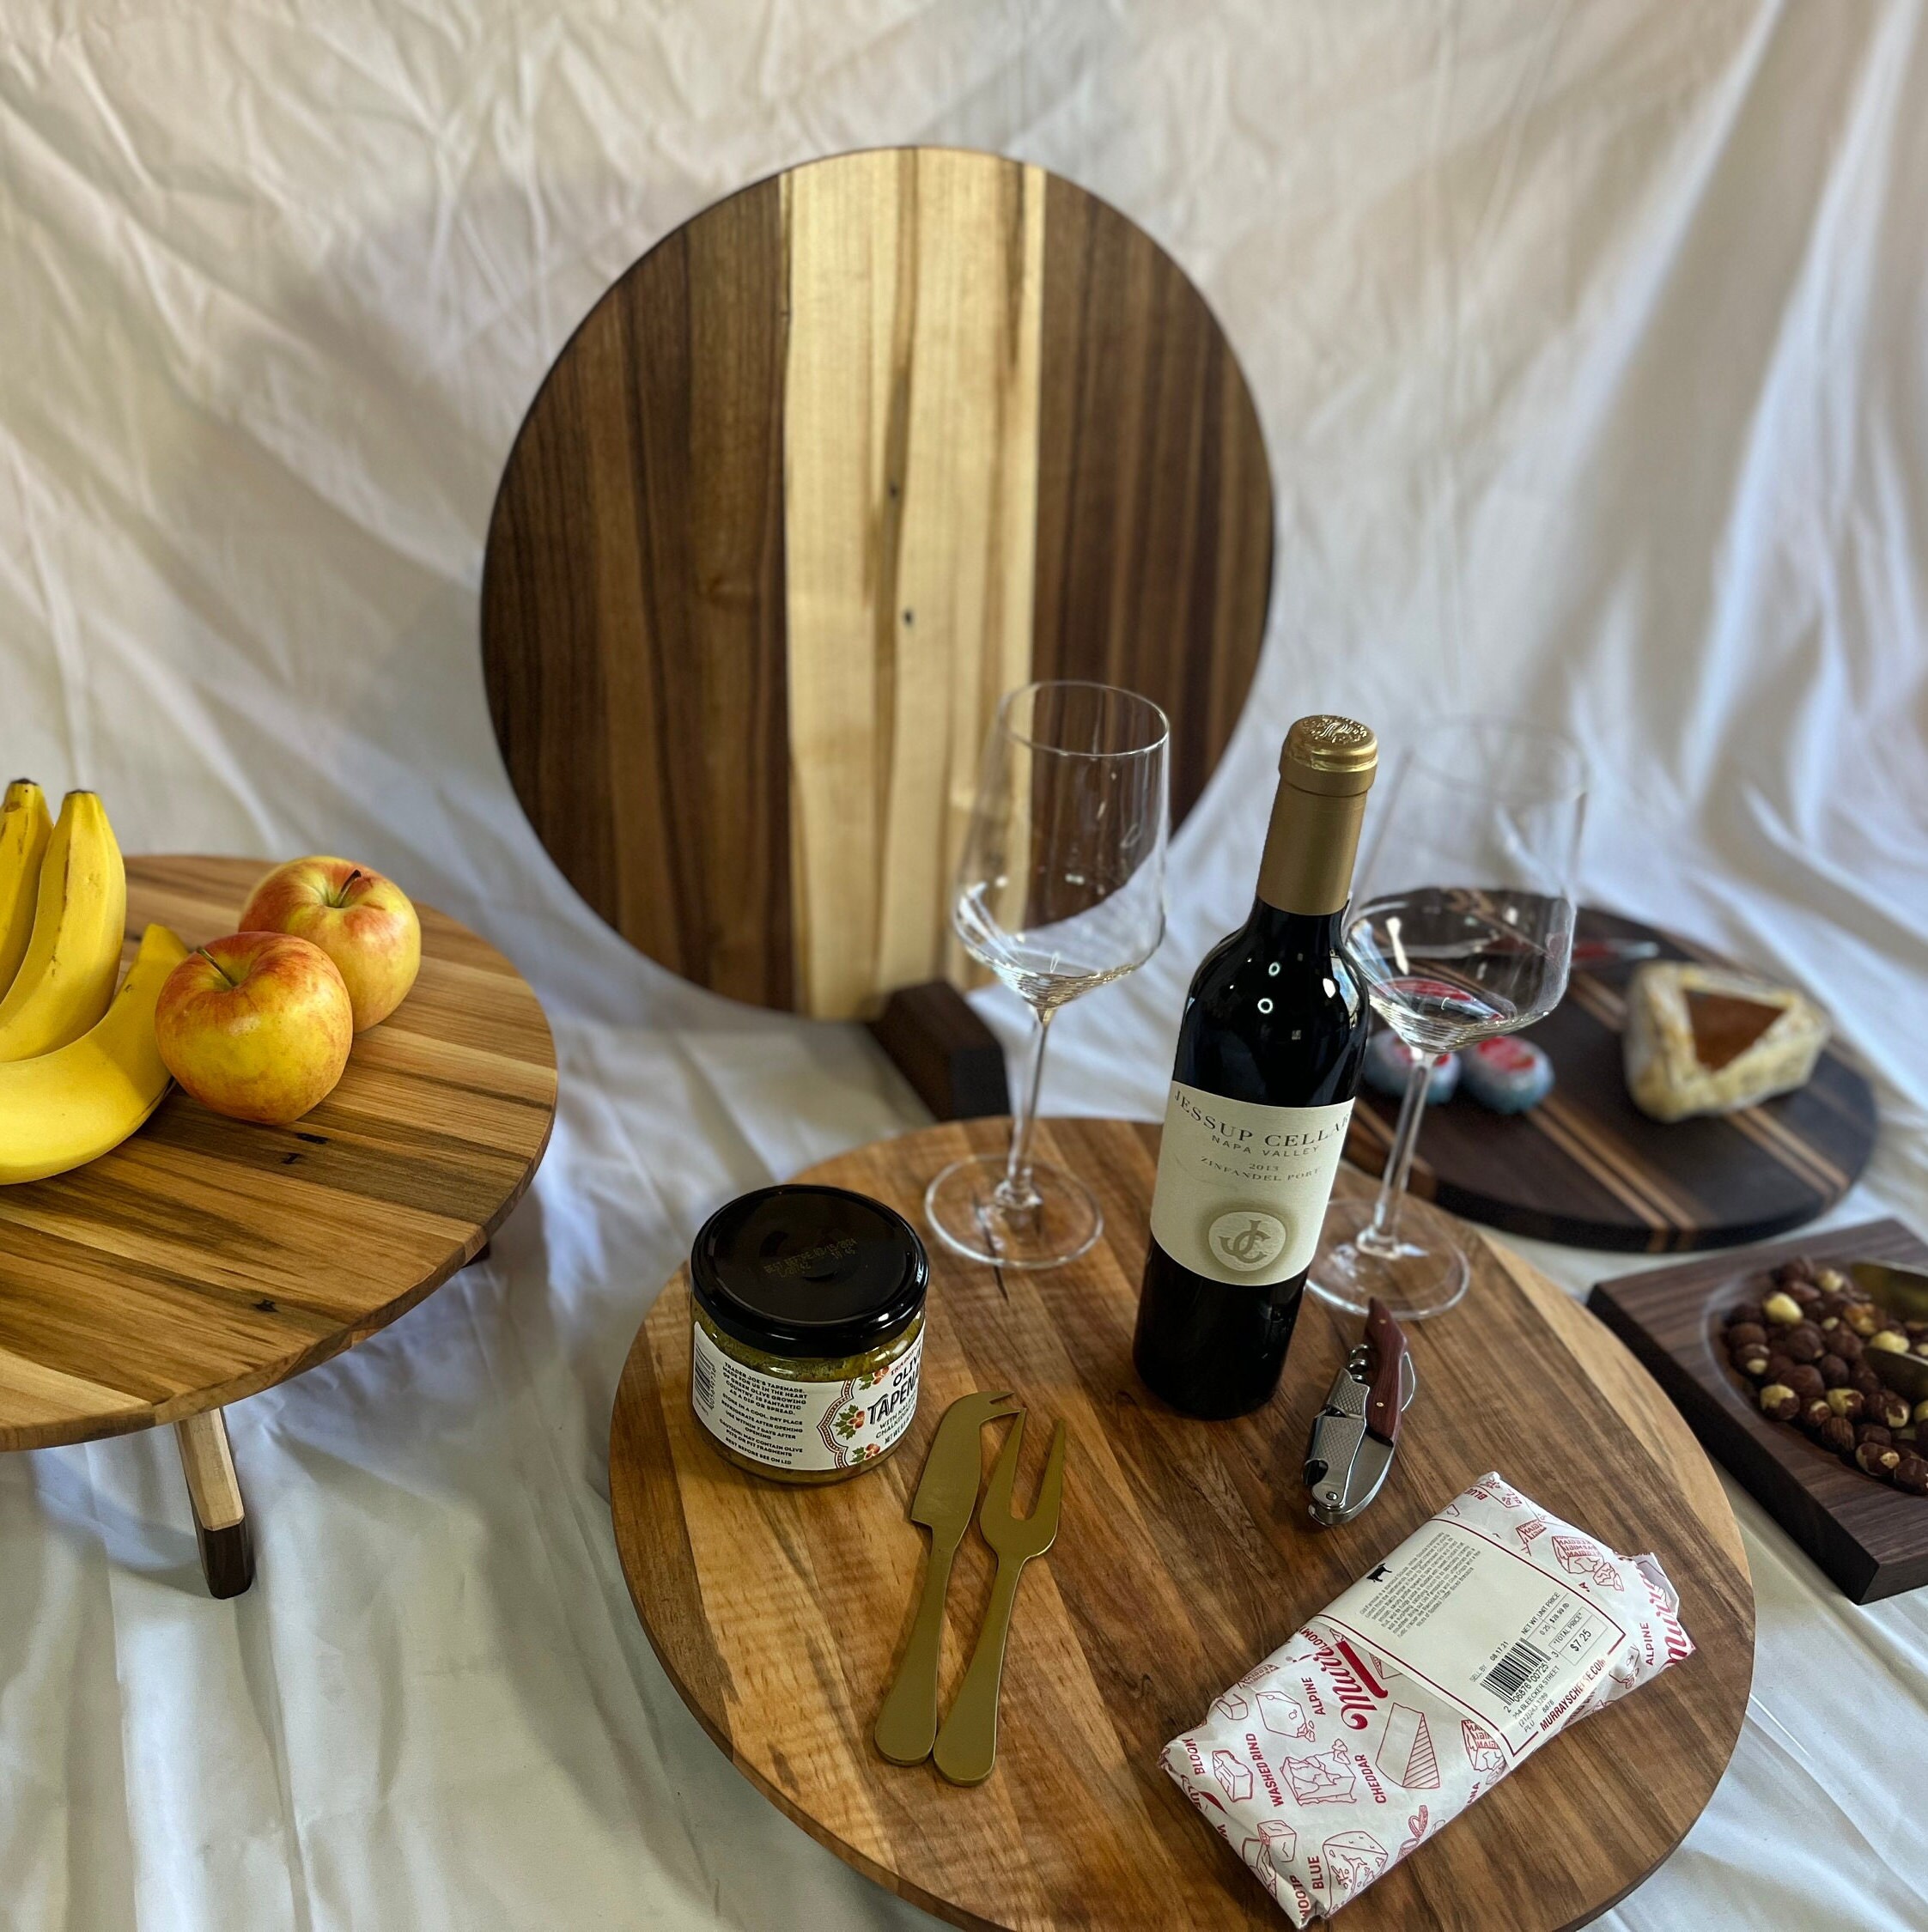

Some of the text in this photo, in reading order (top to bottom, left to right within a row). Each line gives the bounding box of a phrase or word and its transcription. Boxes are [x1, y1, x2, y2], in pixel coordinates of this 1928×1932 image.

[1174, 1091, 1254, 1142] JESSUP
[1212, 1134, 1319, 1157] NAPA VALLEY
[1201, 1156, 1323, 1182] ZINFANDEL PORT
[723, 1366, 738, 1379] MADE
[725, 1362, 747, 1378] TRADER
[748, 1376, 766, 1386] JOE'S
[731, 1377, 750, 1390] GREEN
[751, 1388, 769, 1399] OLIVE
[771, 1395, 806, 1405] GROWING
[764, 1400, 801, 1410] FANTASTIC
[735, 1417, 756, 1429] WITHIN
[745, 1427, 771, 1439] OPENING
[756, 1419, 774, 1428] AFTER
[774, 1425, 803, 1433] OPENING
[738, 1444, 758, 1456] BEFORE
[756, 1439, 783, 1450] CONTAIN
[757, 1445, 792, 1456] FRAGMENTS
[1521, 1591, 1560, 1635] NET WT UNIT PRICE
[1639, 1622, 1655, 1666] ALPINE
[1512, 1682, 1532, 1703] 06876
[1530, 1662, 1549, 1683] 00725
[1520, 1683, 1545, 1711] BLEECKER
[1542, 1665, 1560, 1686] STREET
[1301, 1677, 1326, 1716] ALPINE
[1524, 1719, 1536, 1733] PLU
[1245, 1733, 1284, 1807] WASHED RIND
[1354, 1754, 1387, 1803] CHEDDAR
[1308, 1856, 1324, 1889] BLUE
